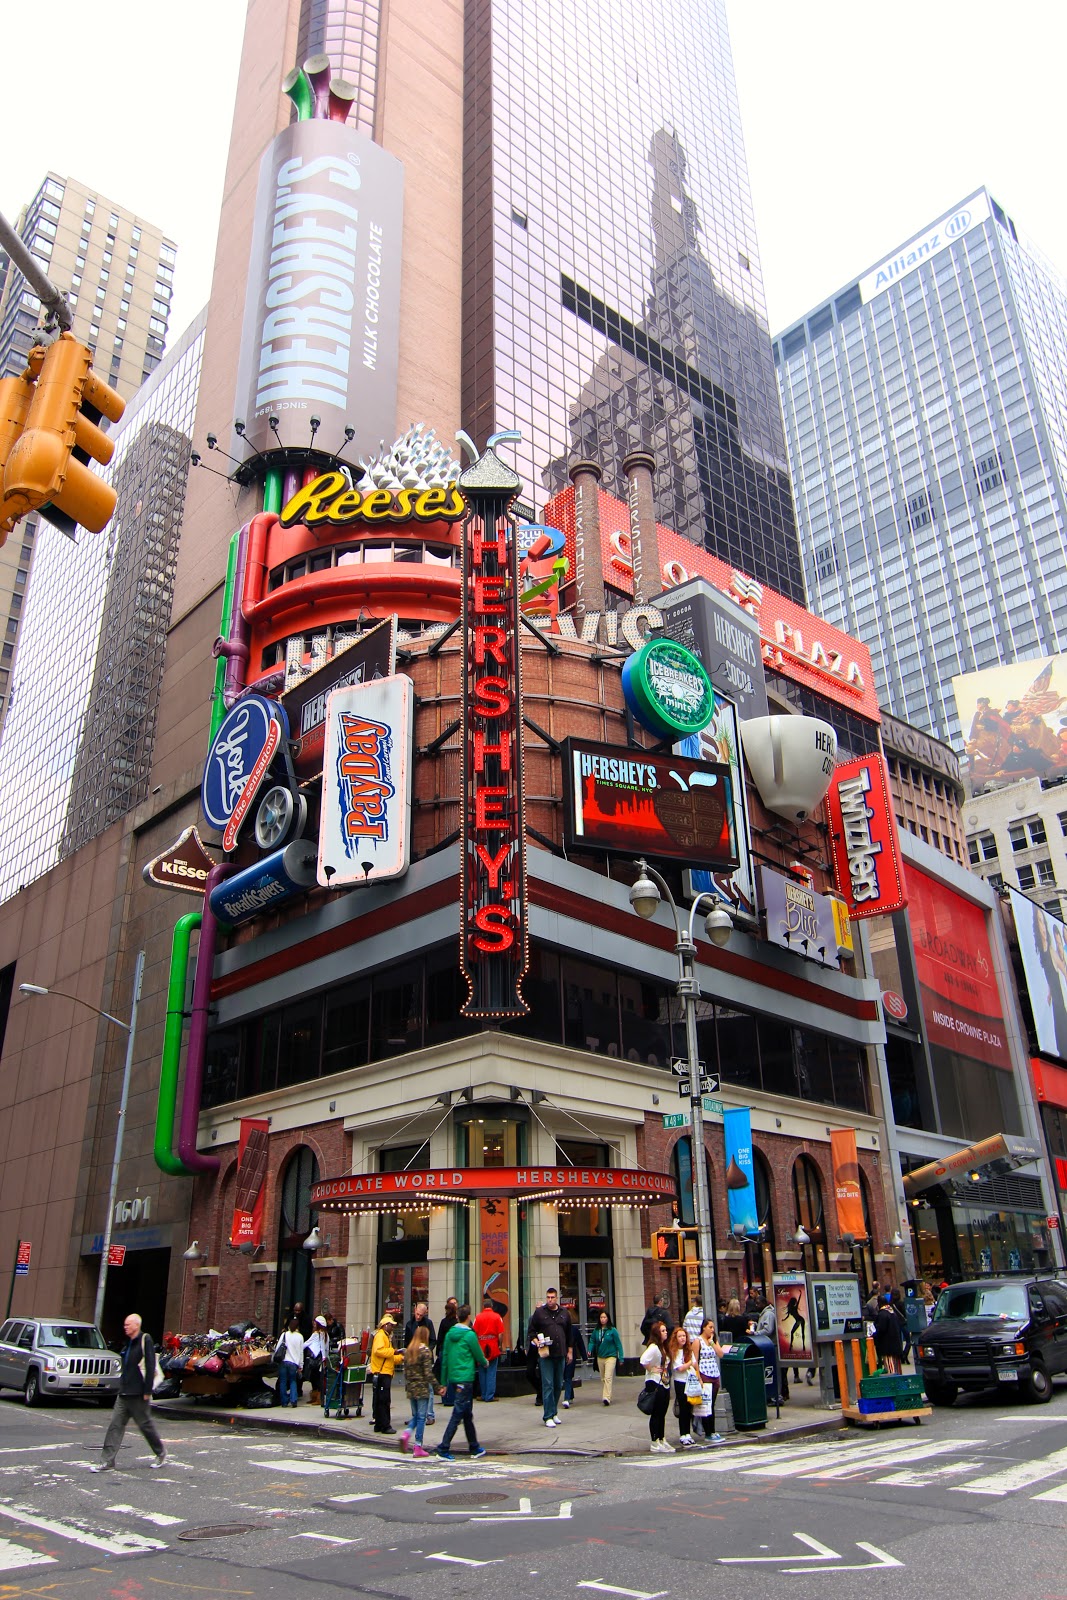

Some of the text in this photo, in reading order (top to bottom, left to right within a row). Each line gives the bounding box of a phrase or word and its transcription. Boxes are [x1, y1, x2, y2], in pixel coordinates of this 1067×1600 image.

[875, 234, 941, 290] Allianz
[256, 156, 361, 410] HERSHEY'S
[362, 221, 383, 370] MILK CHOCOLATE
[276, 402, 307, 410] SINCE
[713, 611, 757, 668] HERSHEY'S
[775, 619, 866, 688] PLAZA
[665, 697, 692, 713] mints
[473, 529, 514, 952] HERSHEY'S
[340, 714, 391, 838] PayDay
[581, 753, 657, 789] HERSHEY'S
[596, 779, 613, 788] TIMES
[225, 733, 276, 846] Get the sensation!
[785, 901, 818, 940] Bliss
[932, 1010, 1002, 1048] INSIDE CROWNE PLAZA
[701, 1081, 714, 1090] WAY
[670, 1115, 677, 1127] 48
[948, 1143, 1002, 1170] CROWNE PLAZA
[316, 1177, 383, 1198] CHOCOLATE
[395, 1172, 463, 1188] WORLD
[517, 1171, 614, 1184] HERSHEY'S
[115, 1196, 151, 1224] 1601
[481, 1232, 508, 1240] SHARE
[907, 1287, 914, 1297] P
